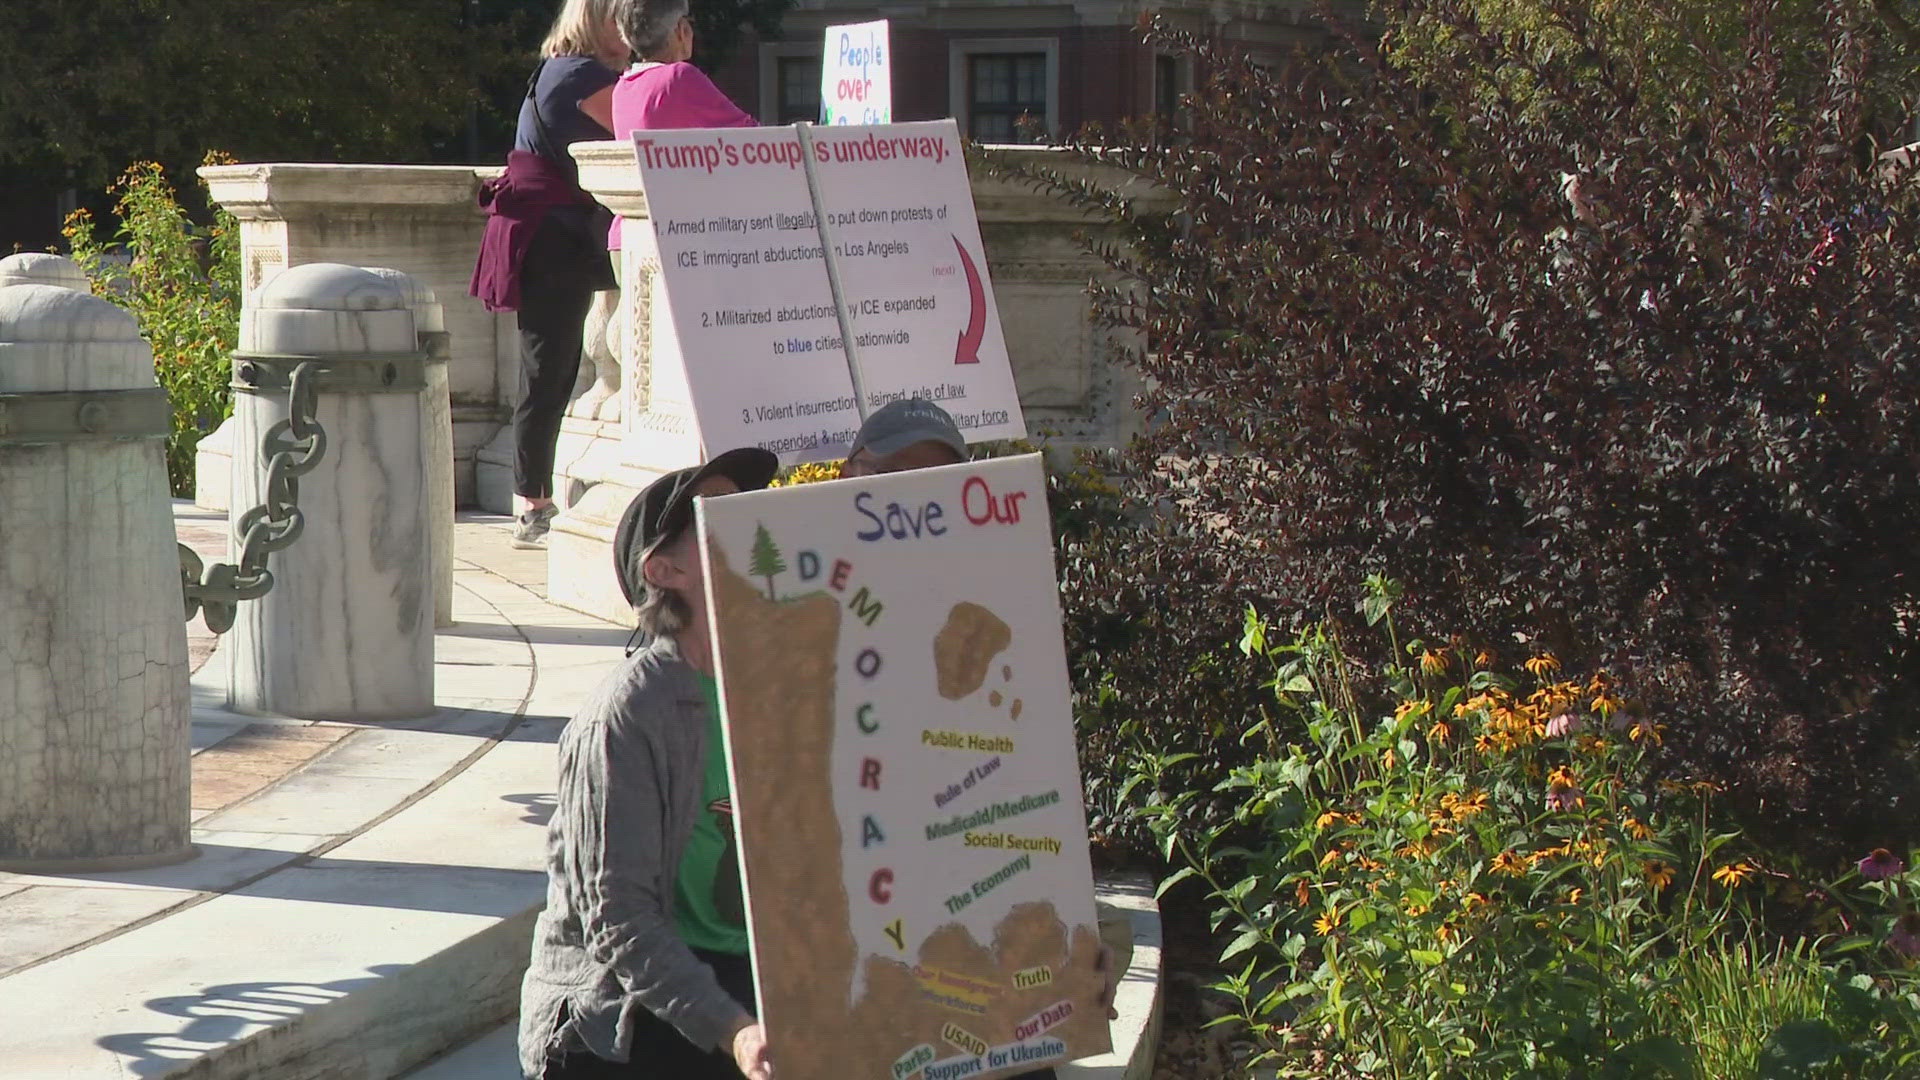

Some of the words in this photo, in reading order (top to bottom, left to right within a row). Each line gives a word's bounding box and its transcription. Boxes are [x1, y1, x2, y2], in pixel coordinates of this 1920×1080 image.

[839, 31, 882, 82] People
[837, 79, 872, 102] over
[637, 137, 739, 173] Trump's
[742, 140, 802, 169] coup
[834, 132, 950, 163] underway.
[668, 219, 705, 235] Armed
[709, 216, 748, 234] military
[751, 214, 773, 230] sent
[776, 211, 815, 229] illegally
[838, 210, 856, 227] put
[858, 206, 888, 222] down
[890, 206, 933, 225] protests
[936, 205, 948, 220] of
[677, 250, 699, 268] ICE
[703, 249, 760, 268] immigrant
[764, 245, 825, 263] abductions
[844, 242, 864, 257] Los
[866, 239, 909, 258] Angeles
[701, 312, 713, 328] 2.
[716, 309, 772, 327] Militarized
[777, 303, 837, 322] abductions
[860, 300, 880, 315] ICE
[884, 296, 936, 314] expanded
[773, 341, 785, 355] to
[787, 338, 812, 353] blue
[815, 335, 843, 351] cities
[742, 409, 753, 424] 3.
[756, 404, 794, 422] Violent
[796, 396, 858, 416] insurrection
[934, 384, 944, 399] of
[948, 383, 965, 397] law
[758, 431, 818, 453] suspended
[822, 430, 829, 444] &
[833, 428, 859, 444] natio
[952, 412, 980, 428] ilitary
[982, 409, 1008, 423] force
[855, 491, 947, 542] Save
[962, 475, 1026, 526] Our
[921, 729, 964, 749] Public
[968, 734, 1014, 753] Health
[934, 784, 962, 808] Rule
[963, 770, 976, 791] of
[977, 756, 1001, 780] Law
[925, 789, 1060, 841] Medicaid/Medicare
[963, 832, 1003, 848] Social
[1007, 835, 1061, 855] Security
[945, 890, 971, 914] The
[972, 853, 1032, 897] Economy
[1014, 967, 1050, 988] Truth
[944, 1023, 987, 1056] USAID
[1015, 1022, 1038, 1041] Our
[1042, 1003, 1073, 1030] Data
[893, 1046, 933, 1079] Parks
[923, 1057, 983, 1080] Support
[988, 1049, 1007, 1067] for
[1011, 1037, 1065, 1063] Ukraine
